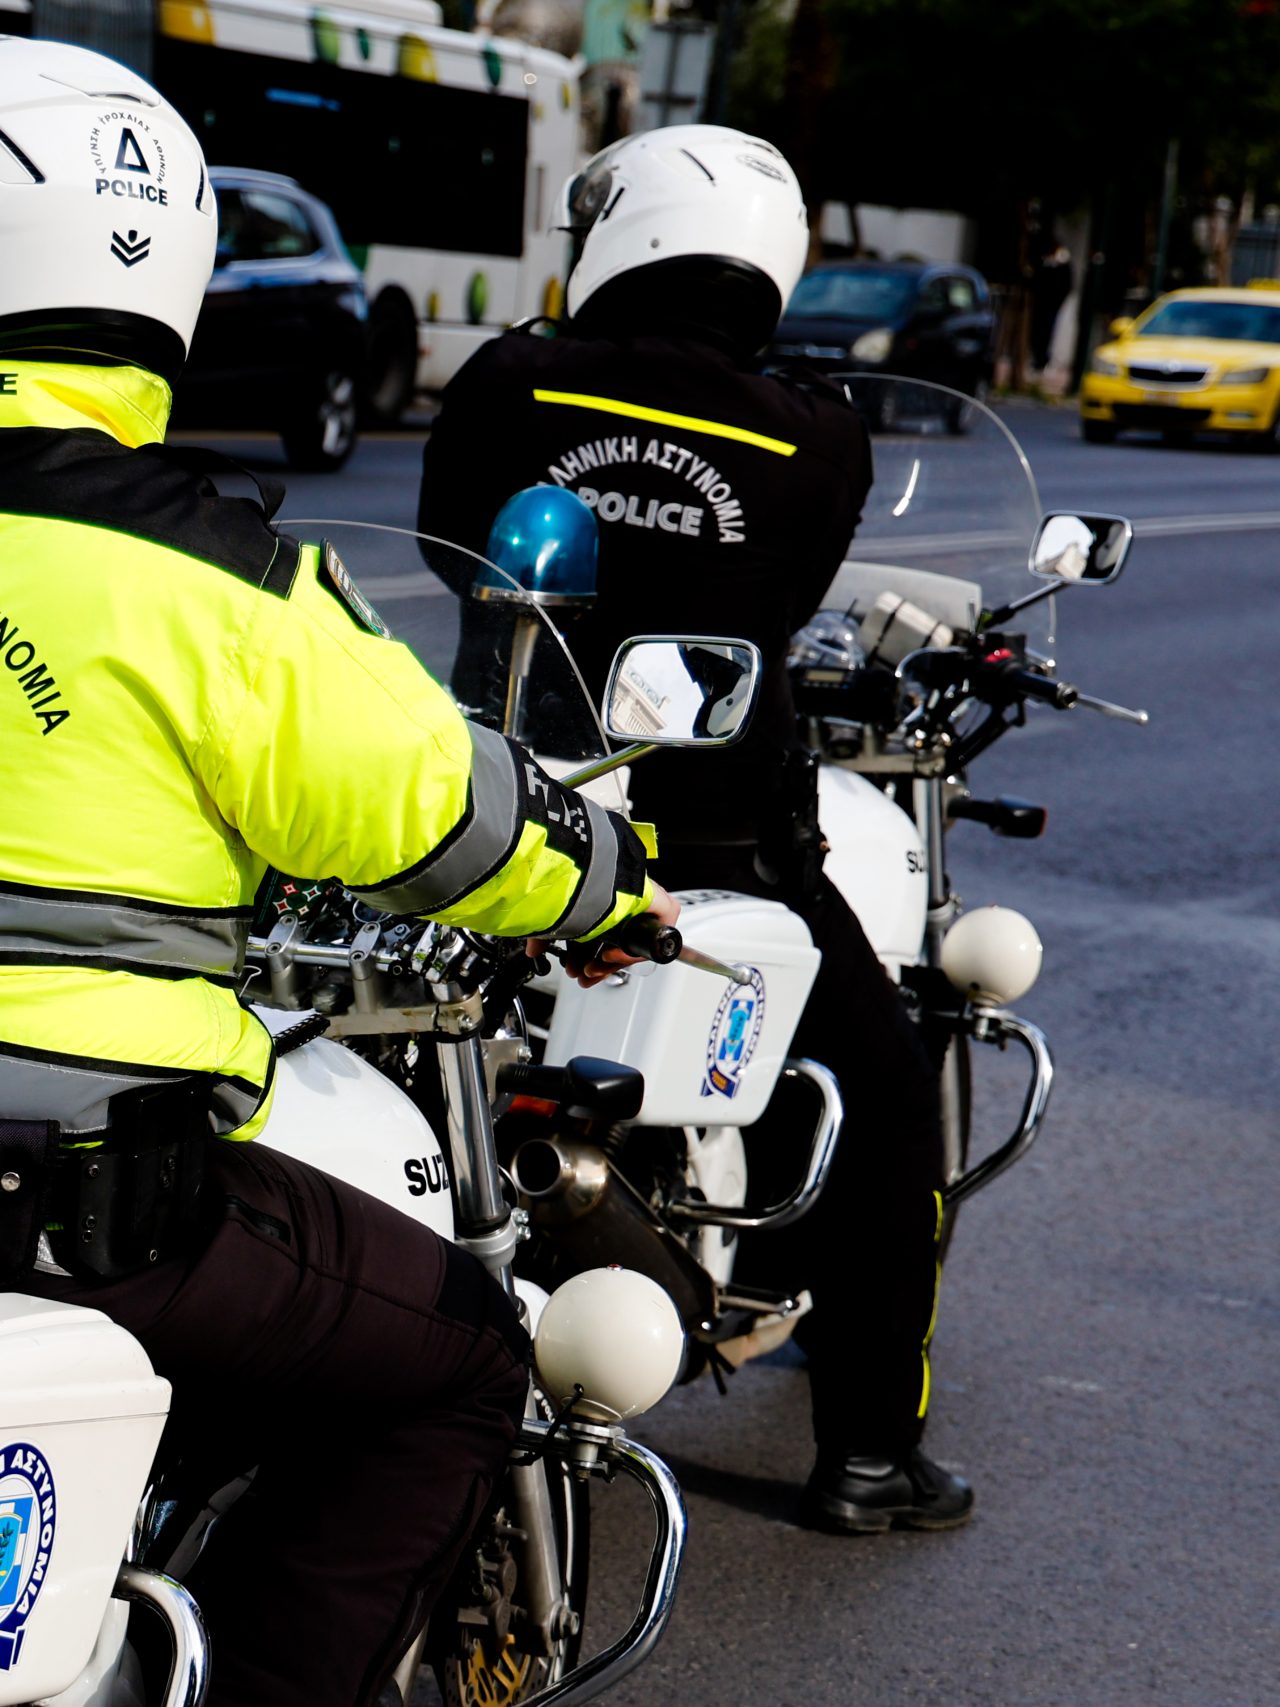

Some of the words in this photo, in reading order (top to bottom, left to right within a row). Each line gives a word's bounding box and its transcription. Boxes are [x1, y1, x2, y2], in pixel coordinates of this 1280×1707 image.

[95, 178, 169, 207] POLICE
[578, 486, 704, 537] POLICE
[642, 439, 746, 543] ΑΣΤΥΝΟΜΙΑ
[11, 1448, 55, 1615] ΑΣΤΥΝΟΜΙΑ
